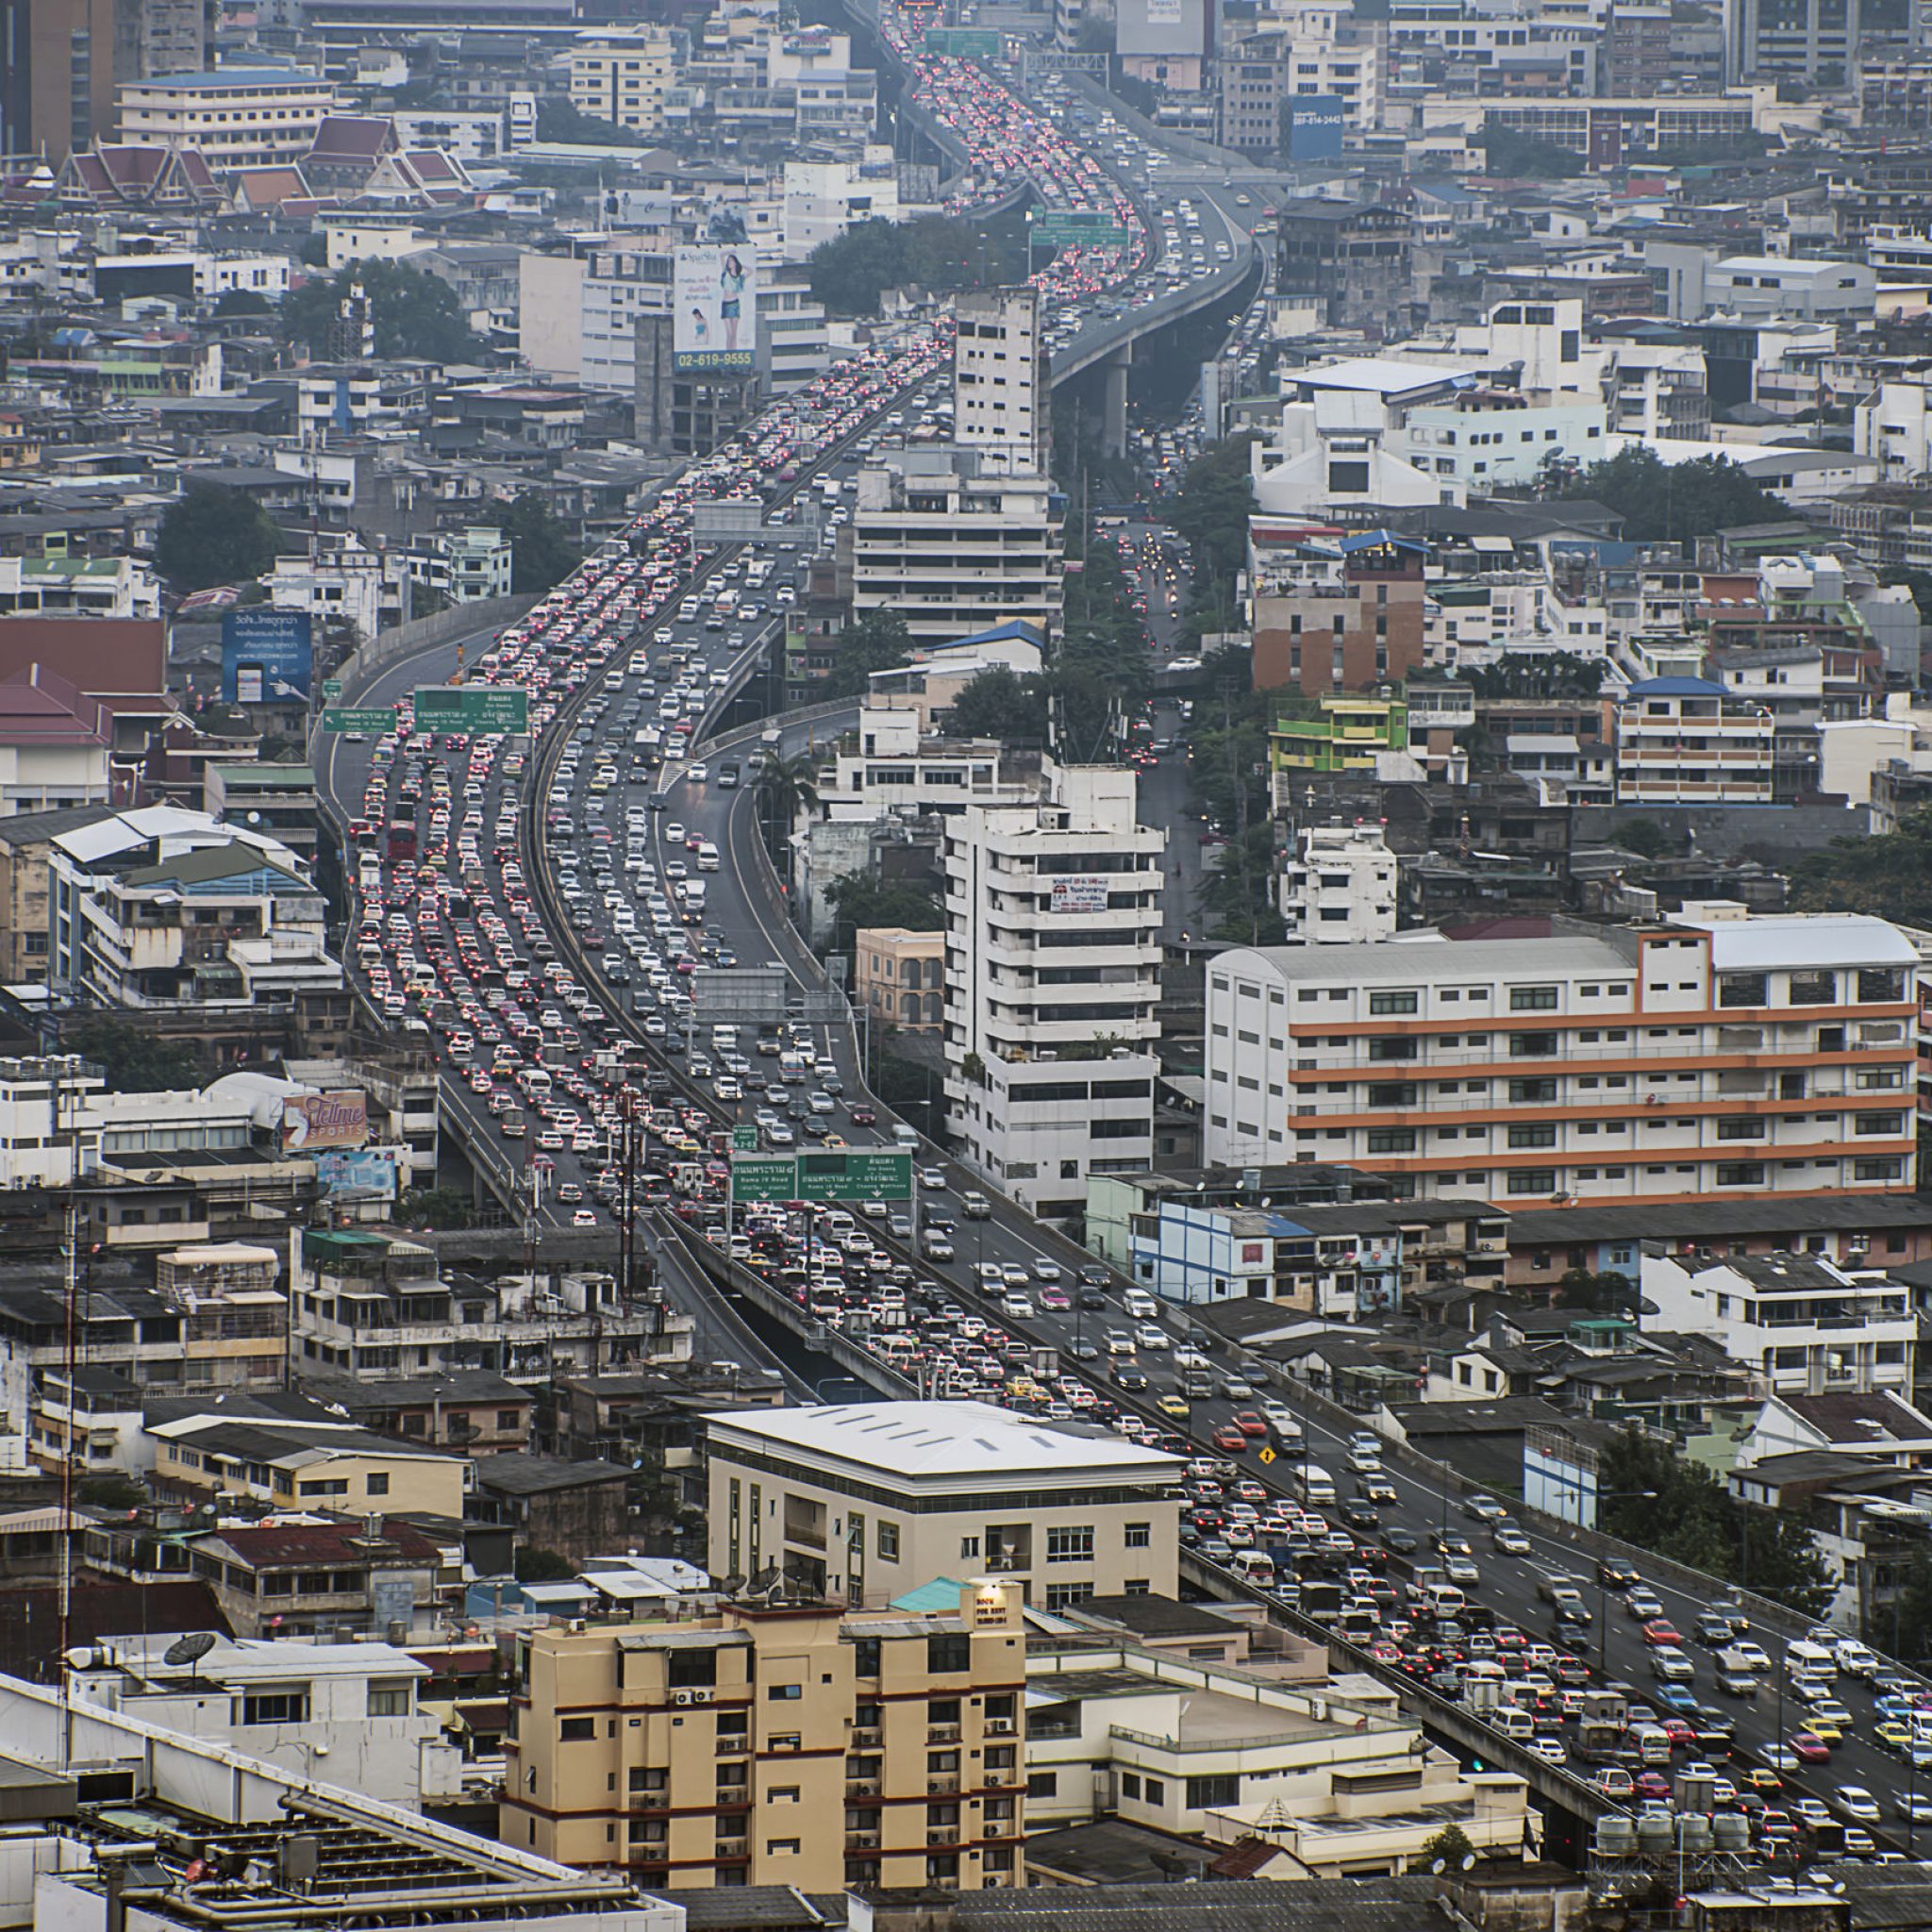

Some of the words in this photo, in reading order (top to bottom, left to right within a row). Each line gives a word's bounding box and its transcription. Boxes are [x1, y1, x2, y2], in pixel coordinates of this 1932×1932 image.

[678, 353, 752, 366] 02-619-9555
[306, 1096, 363, 1126] Tellme
[309, 1124, 364, 1139] SPORTS
[869, 1155, 894, 1165] ดินแดง
[733, 1166, 785, 1174] ถนนพระราม
